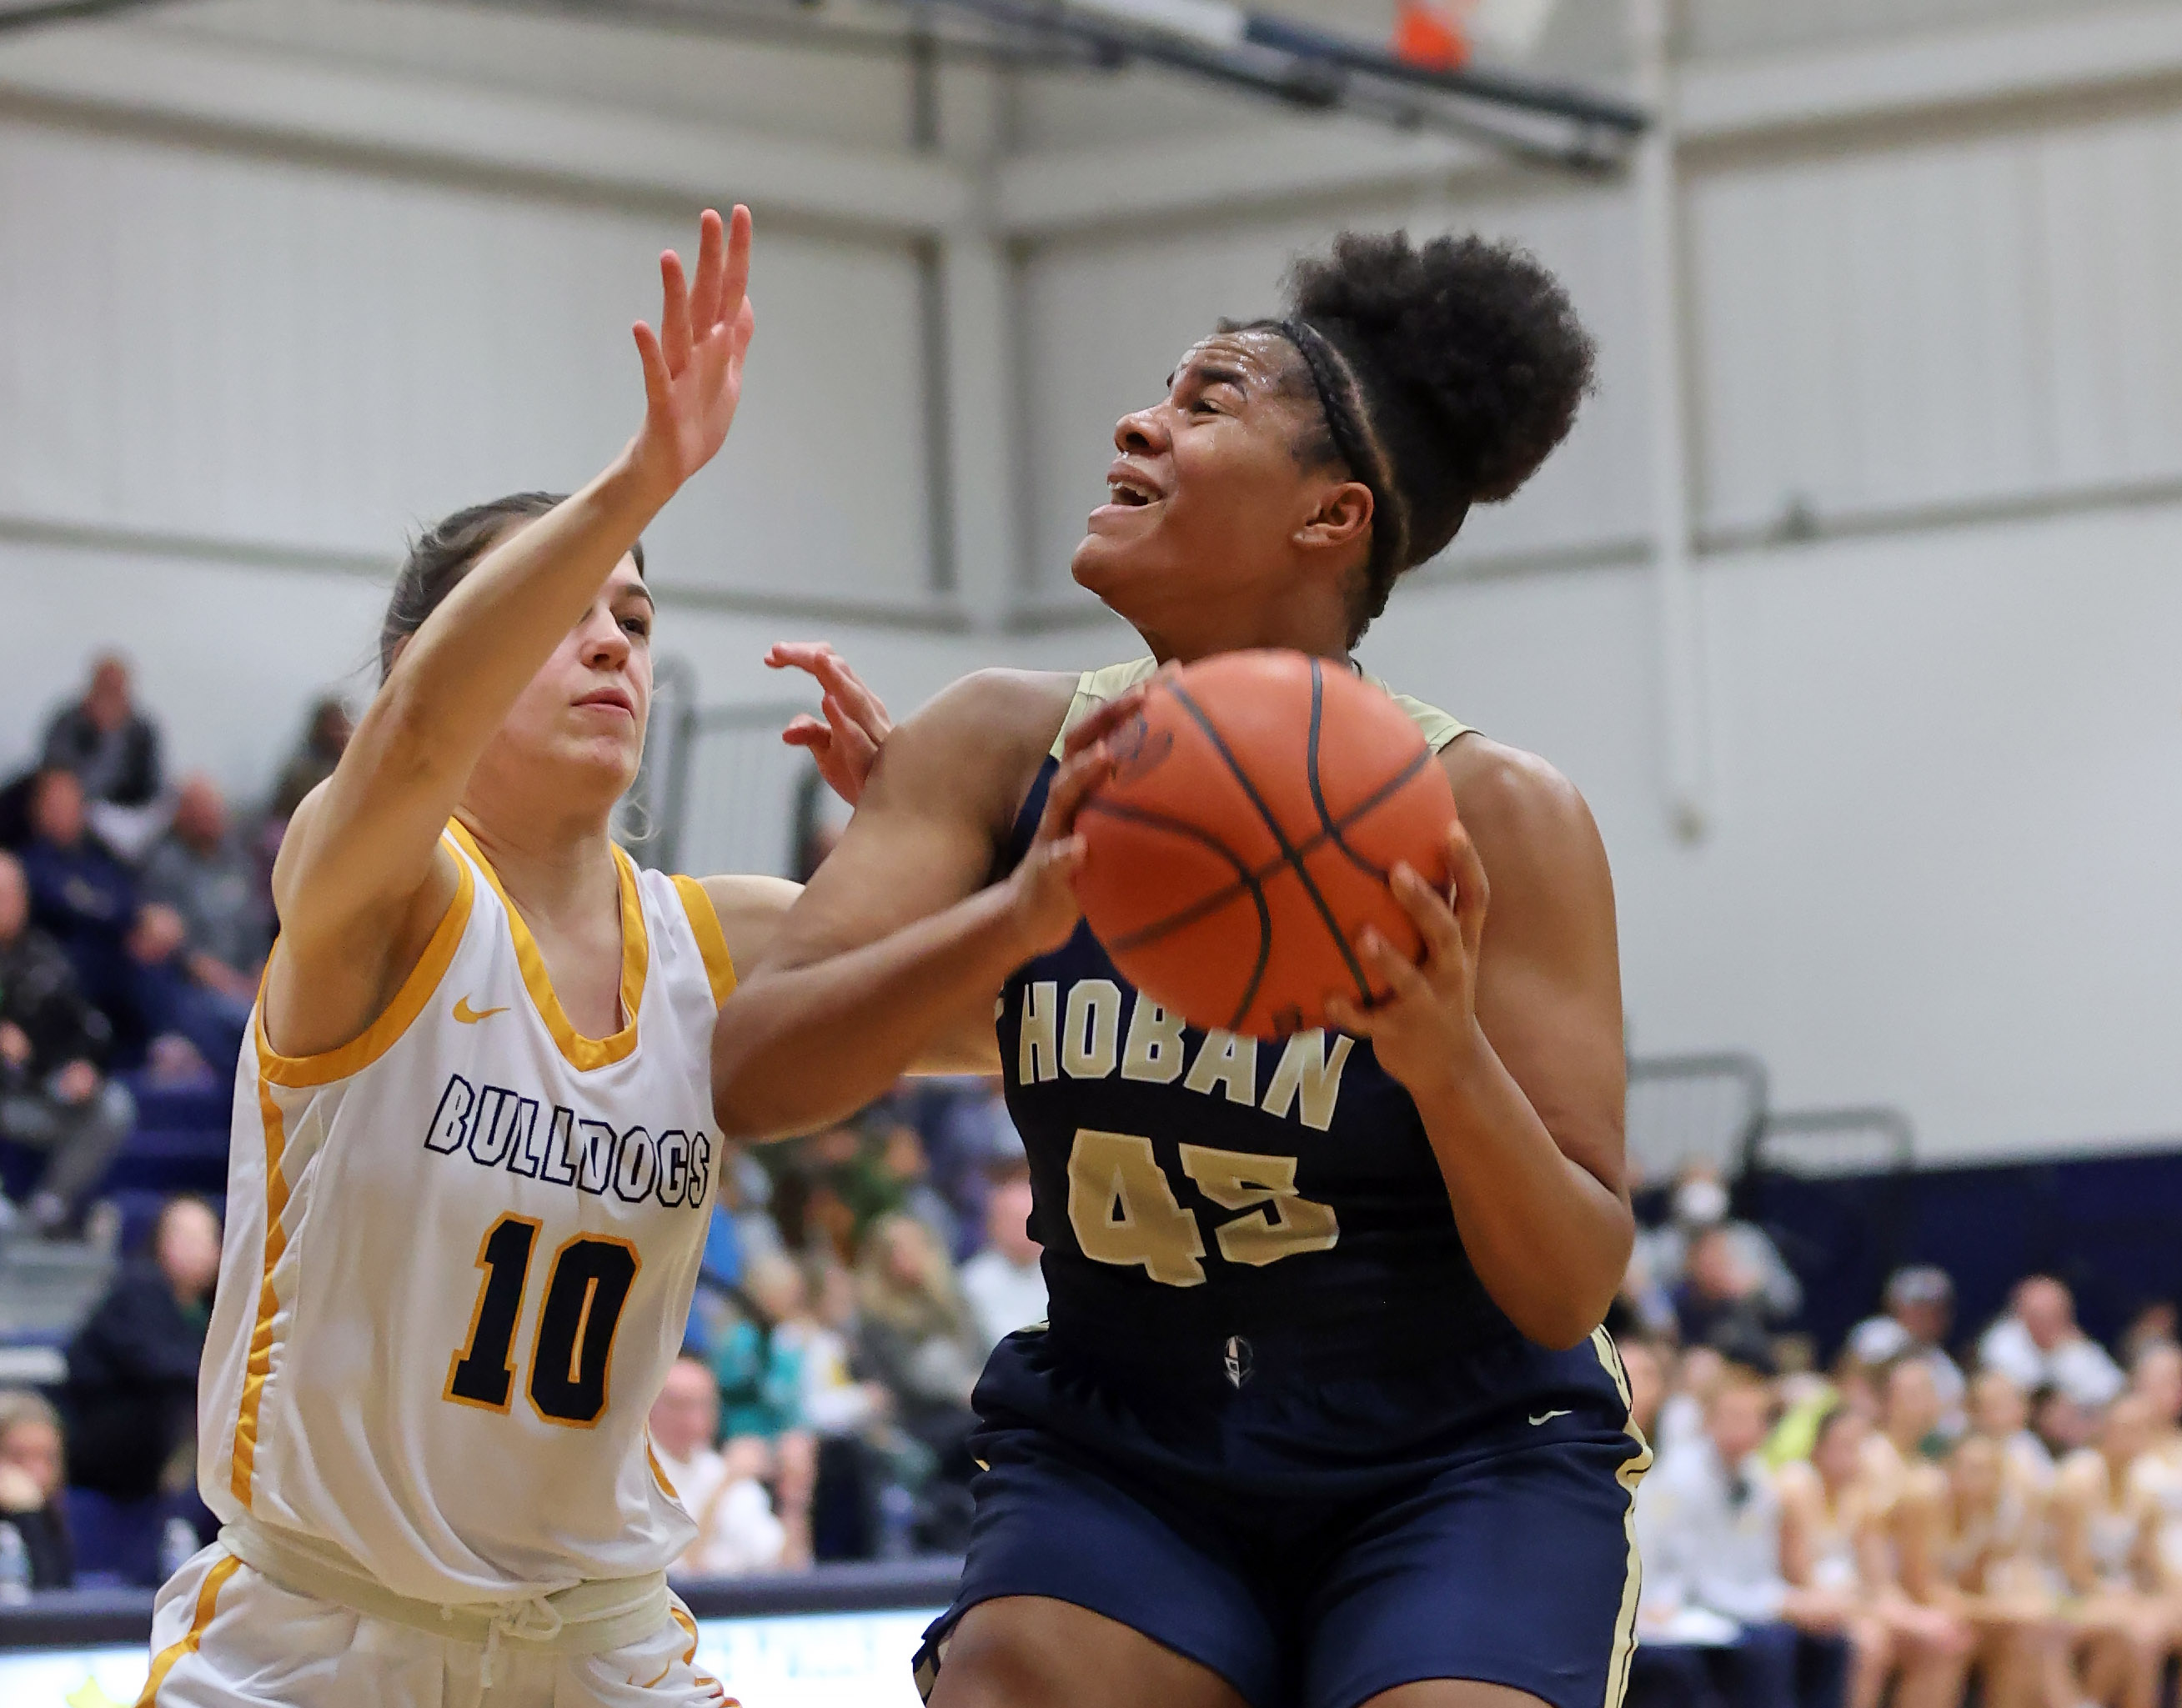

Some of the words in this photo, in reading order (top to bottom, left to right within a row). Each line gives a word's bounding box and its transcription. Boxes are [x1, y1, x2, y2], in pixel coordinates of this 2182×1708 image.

[1020, 979, 1355, 1131] HOBAN
[424, 1074, 710, 1208] BULLDOGS
[1067, 1129, 1340, 1287] 45
[442, 1210, 642, 1430] 10
